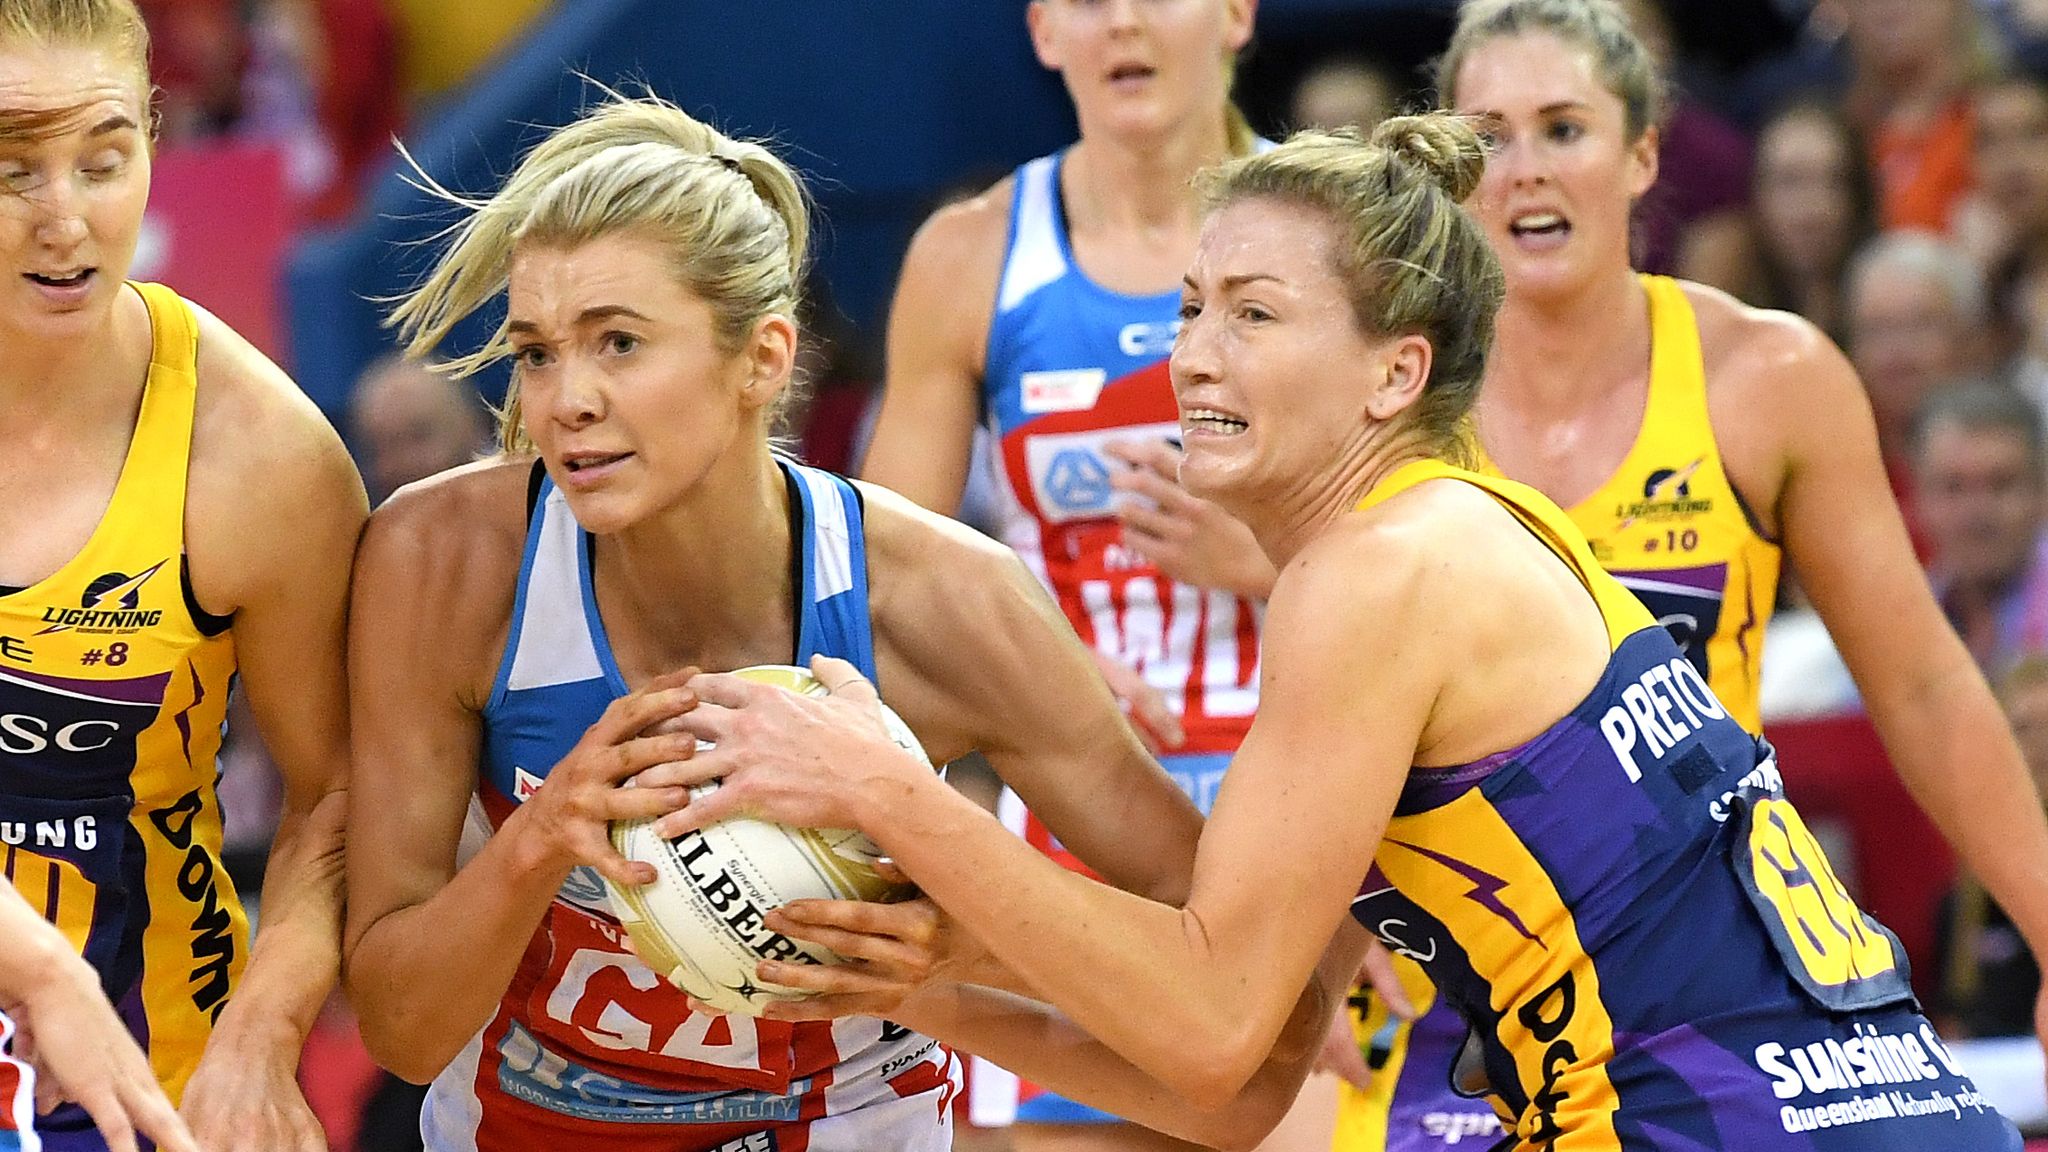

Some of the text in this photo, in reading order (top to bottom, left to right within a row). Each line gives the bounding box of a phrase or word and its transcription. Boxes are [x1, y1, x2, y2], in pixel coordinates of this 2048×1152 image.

[41, 607, 162, 627] LIGHTNING
[80, 642, 129, 666] #8
[1600, 658, 1733, 784] PRETO
[149, 786, 235, 1029] Down
